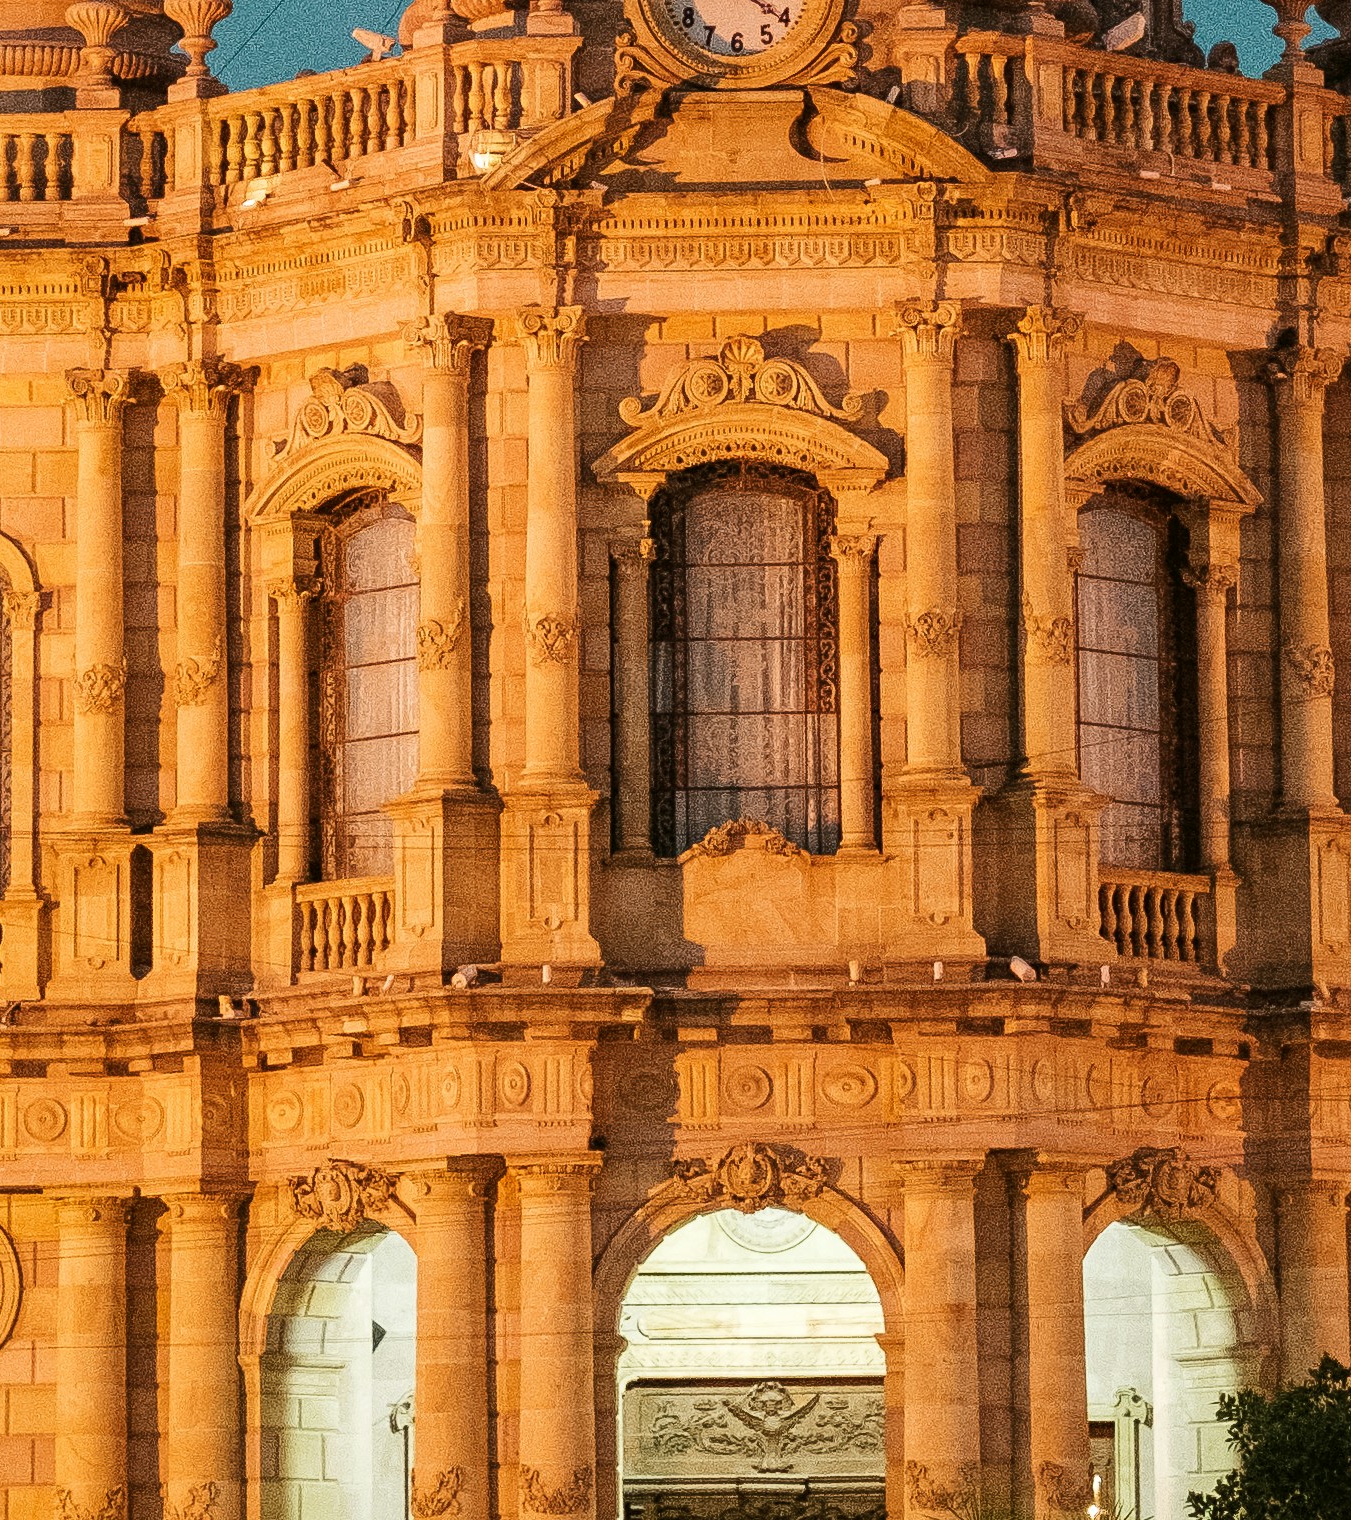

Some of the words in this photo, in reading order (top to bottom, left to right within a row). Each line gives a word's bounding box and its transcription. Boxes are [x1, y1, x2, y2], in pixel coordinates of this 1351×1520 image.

[682, 6, 695, 29] 8
[778, 7, 791, 27] 4
[702, 25, 717, 47] 7
[730, 32, 744, 53] 6
[760, 24, 774, 45] 5
